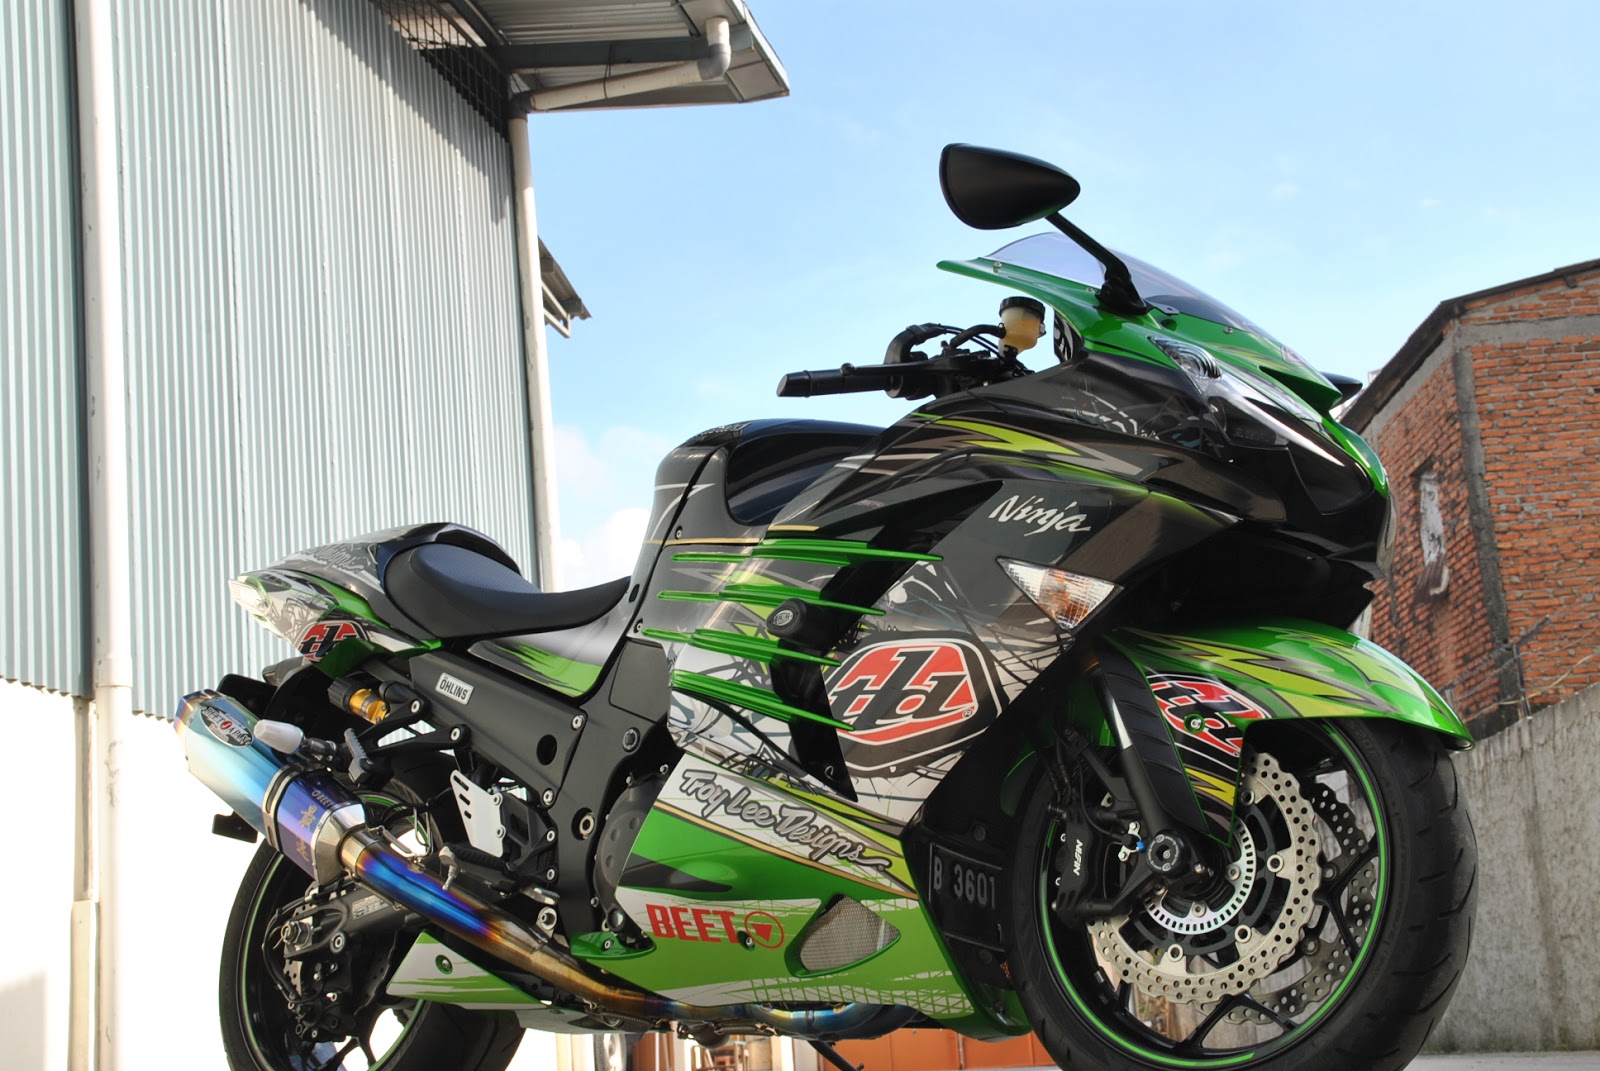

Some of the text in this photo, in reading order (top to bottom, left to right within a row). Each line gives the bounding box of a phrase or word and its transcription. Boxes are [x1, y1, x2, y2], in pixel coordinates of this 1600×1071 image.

[988, 495, 1092, 537] Ninja
[439, 676, 469, 701] ÖHLINS
[679, 769, 892, 868] Troy Lee Designs
[933, 855, 996, 911] B 3601
[646, 904, 740, 944] BEET
